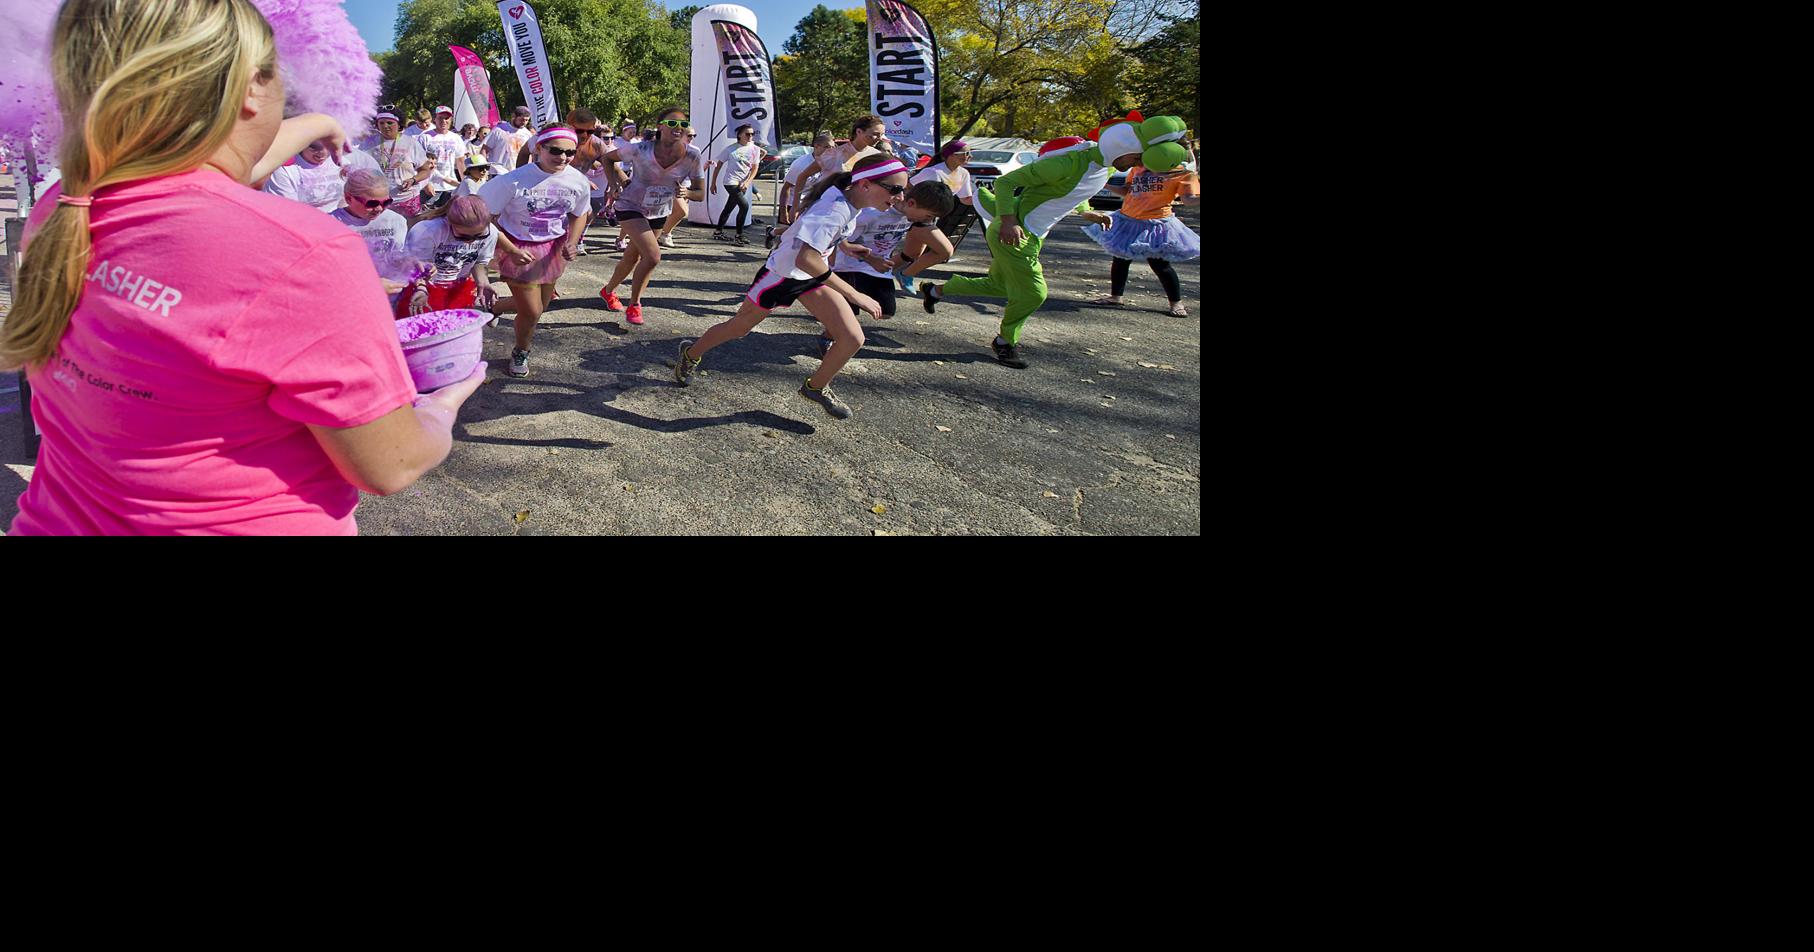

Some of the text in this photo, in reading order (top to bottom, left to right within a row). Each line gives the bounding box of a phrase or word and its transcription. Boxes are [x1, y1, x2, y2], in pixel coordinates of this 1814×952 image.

[512, 22, 547, 129] LET THE COLOR MOVE YOU
[722, 50, 768, 121] START
[875, 32, 925, 118] START
[71, 362, 85, 380] The
[87, 374, 114, 392] Color
